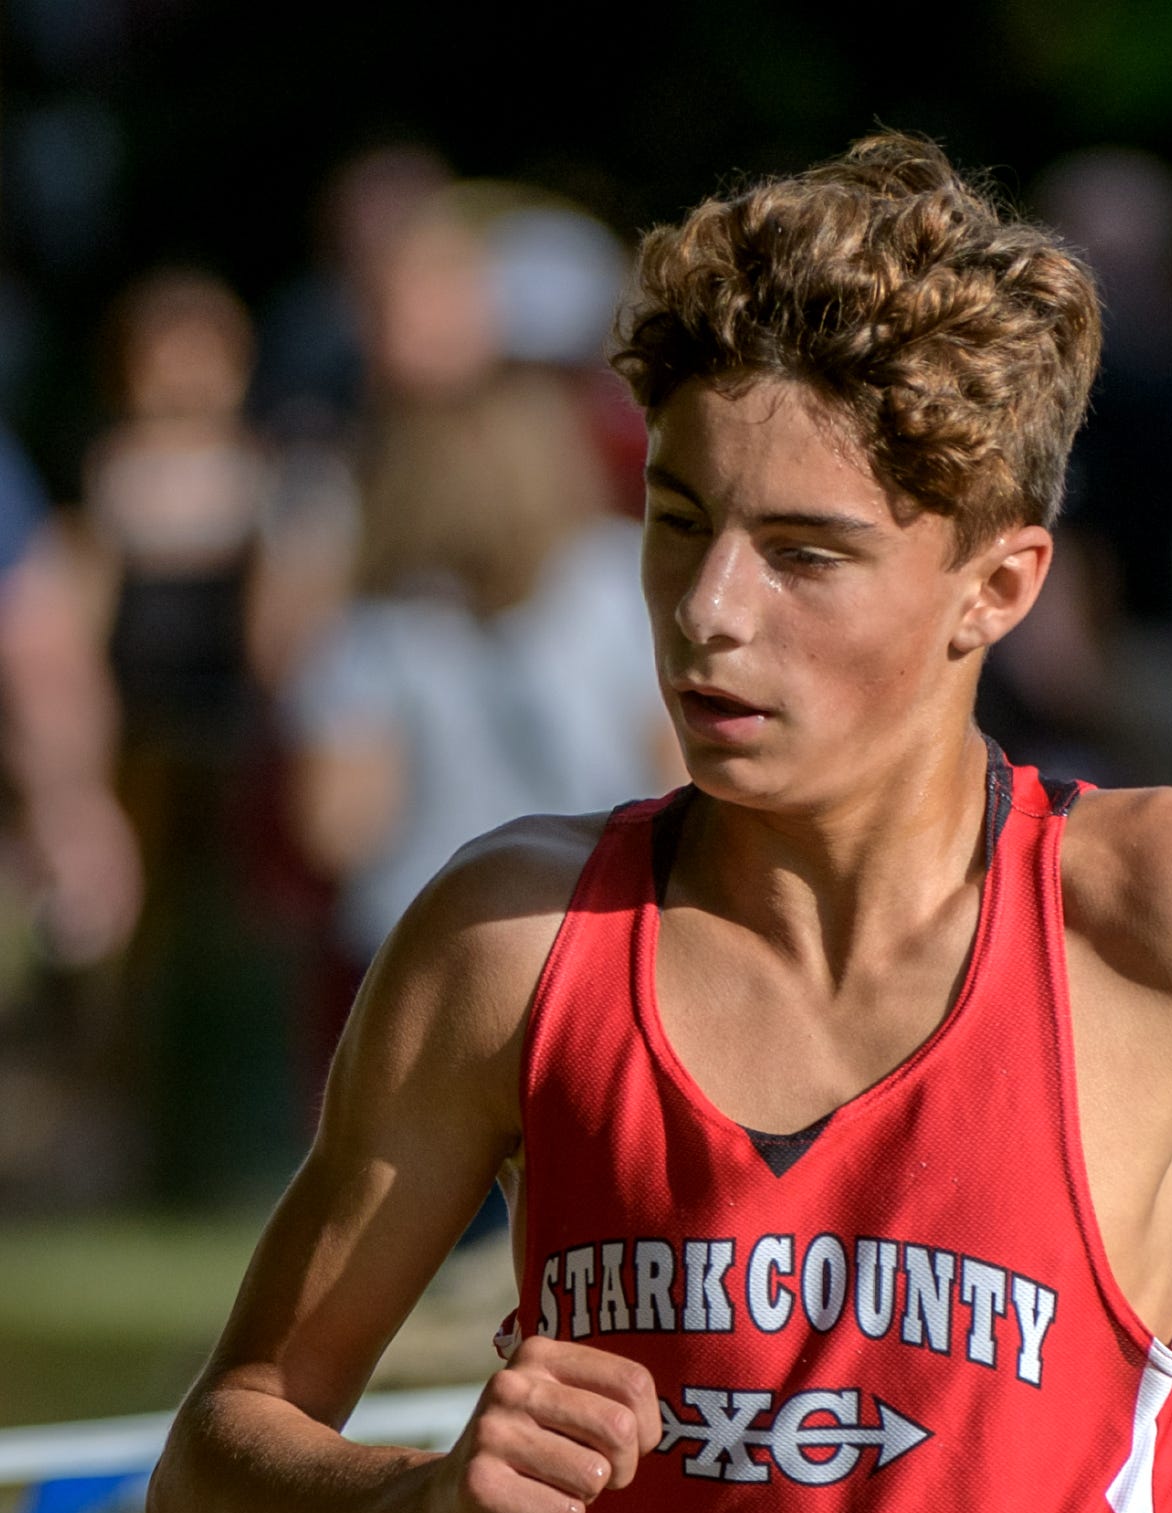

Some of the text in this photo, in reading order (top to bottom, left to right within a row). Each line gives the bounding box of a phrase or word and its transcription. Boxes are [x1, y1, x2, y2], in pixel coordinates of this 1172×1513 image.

[538, 1234, 1058, 1388] STARK COUNTY
[682, 1387, 861, 1486] XC
